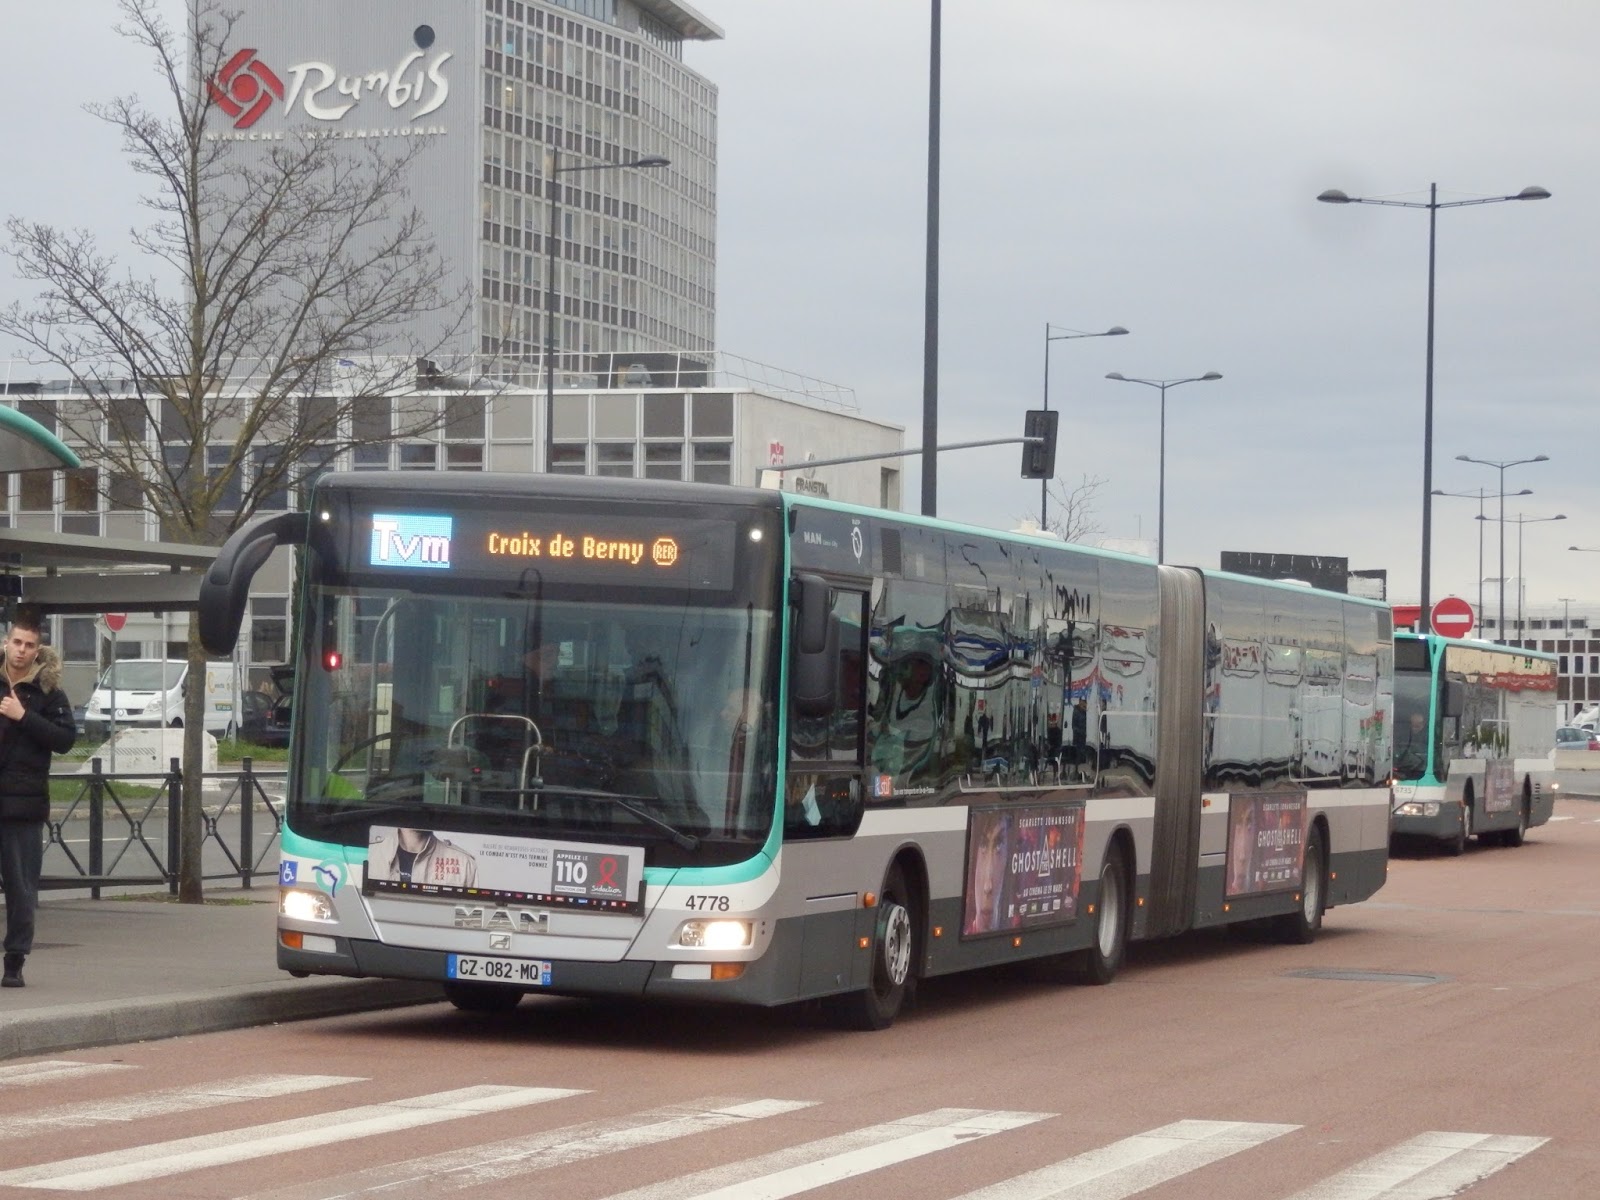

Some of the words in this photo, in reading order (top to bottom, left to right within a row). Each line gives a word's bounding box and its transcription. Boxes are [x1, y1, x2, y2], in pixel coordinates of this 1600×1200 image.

[284, 50, 453, 120] Rungis
[373, 519, 451, 565] Tvm
[488, 532, 541, 556] Croix
[549, 534, 575, 557] de
[582, 537, 644, 565] Berny
[655, 544, 674, 560] RER
[803, 531, 822, 545] MAN
[1019, 817, 1043, 828] SCARLETT
[1045, 815, 1075, 826] JOHANSSON
[528, 861, 548, 869] DONNEZ
[1011, 850, 1041, 874] GHOST
[1050, 847, 1077, 869] SHELL
[556, 861, 588, 884] 110
[685, 895, 730, 911] 4778
[454, 906, 550, 933] MAN
[459, 959, 539, 980] CZ-082-MQ
[543, 974, 551, 982] 75
